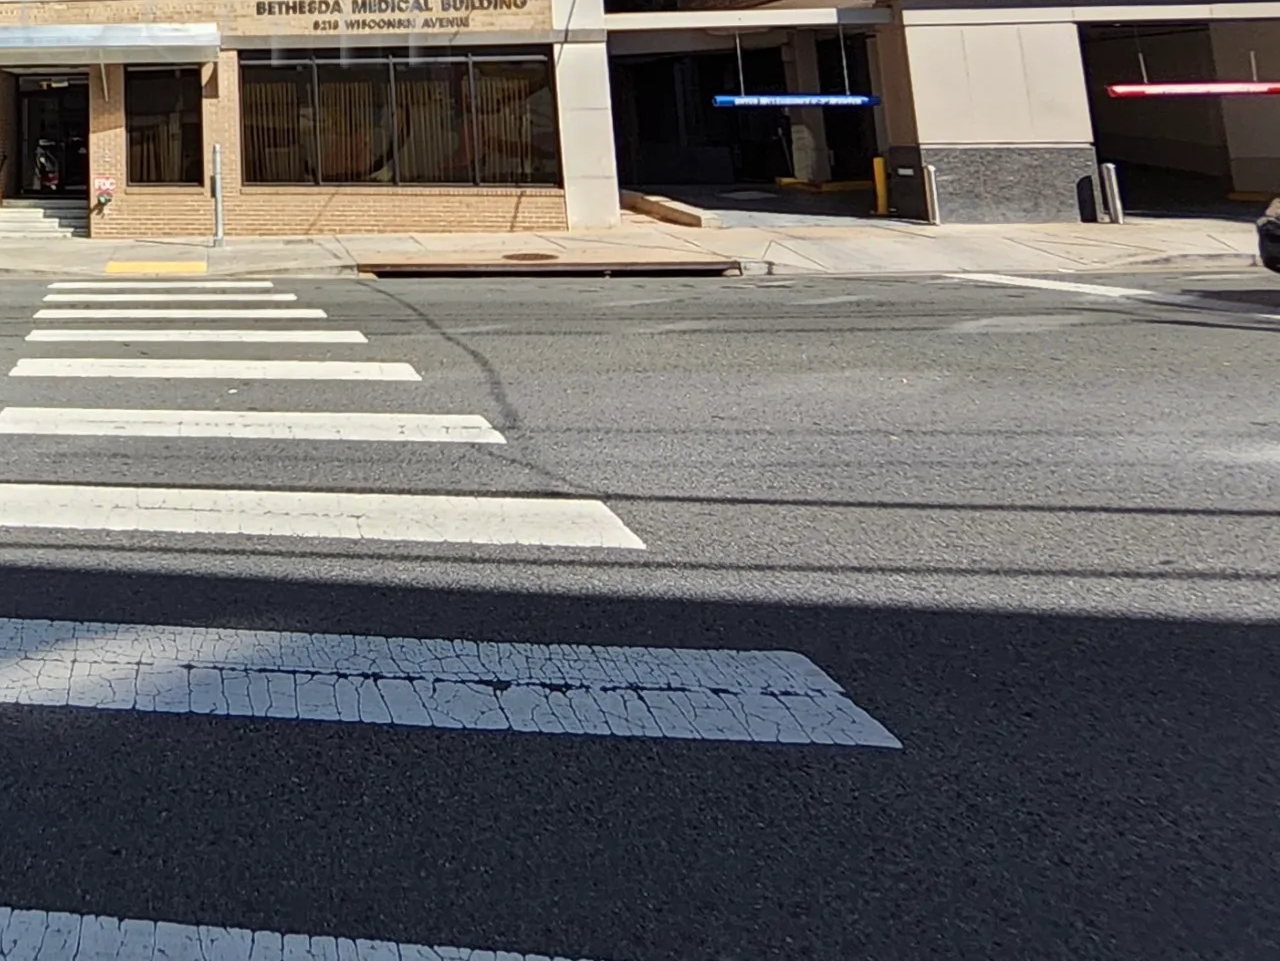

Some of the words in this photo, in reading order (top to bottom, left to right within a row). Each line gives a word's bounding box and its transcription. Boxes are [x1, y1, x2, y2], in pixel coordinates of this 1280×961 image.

[256, 0, 343, 16] BETHESDA
[345, 17, 417, 30] WISCONSIN
[421, 15, 470, 29] AVENUE
[95, 178, 117, 190] FDC
